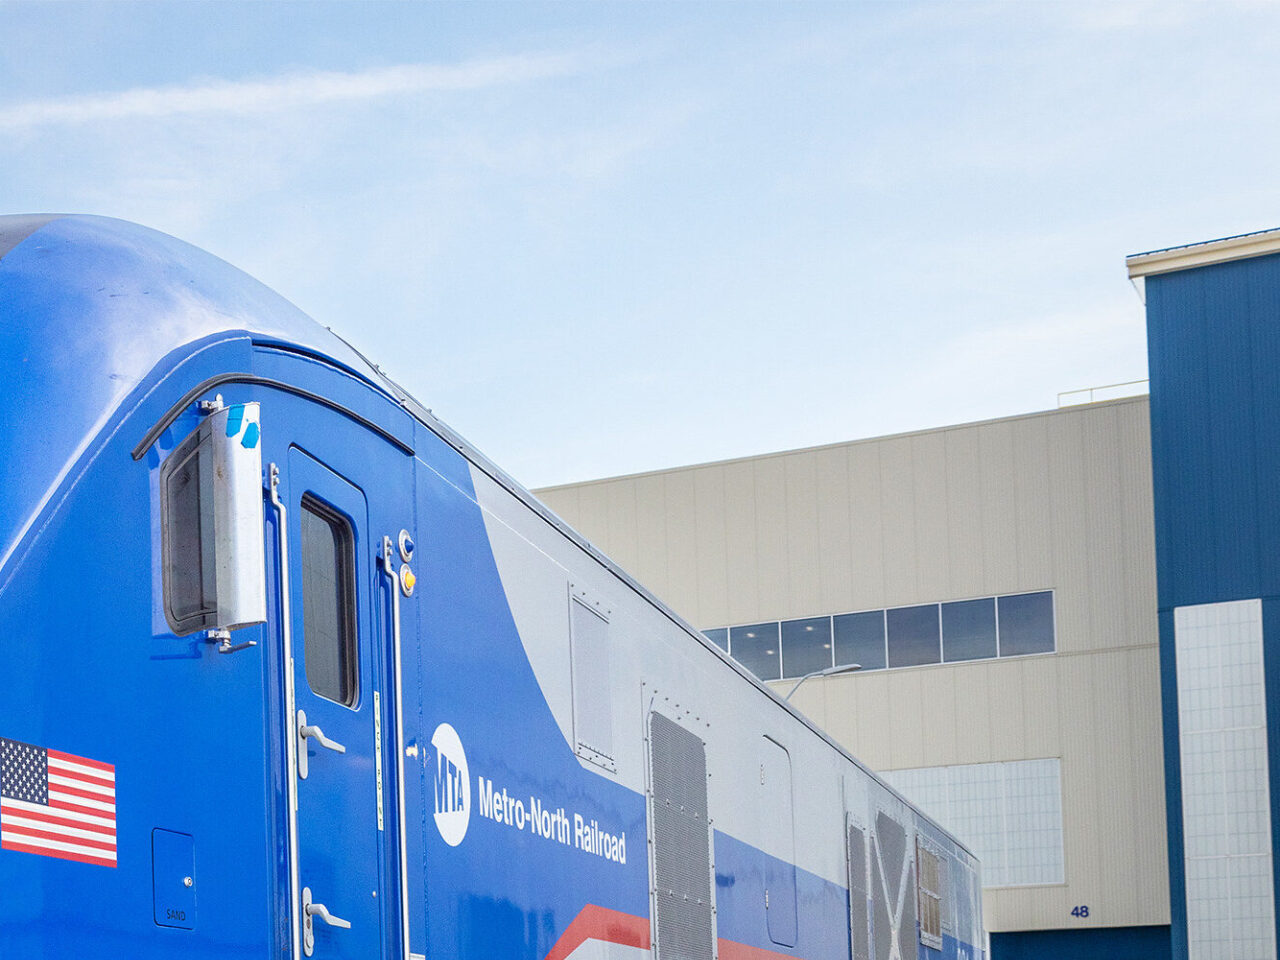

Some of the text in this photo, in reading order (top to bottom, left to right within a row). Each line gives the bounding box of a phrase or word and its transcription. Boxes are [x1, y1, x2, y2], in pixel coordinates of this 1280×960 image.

[478, 775, 627, 865] Metro-North Railroad
[166, 908, 186, 921] SAND
[1070, 905, 1089, 918] 48
